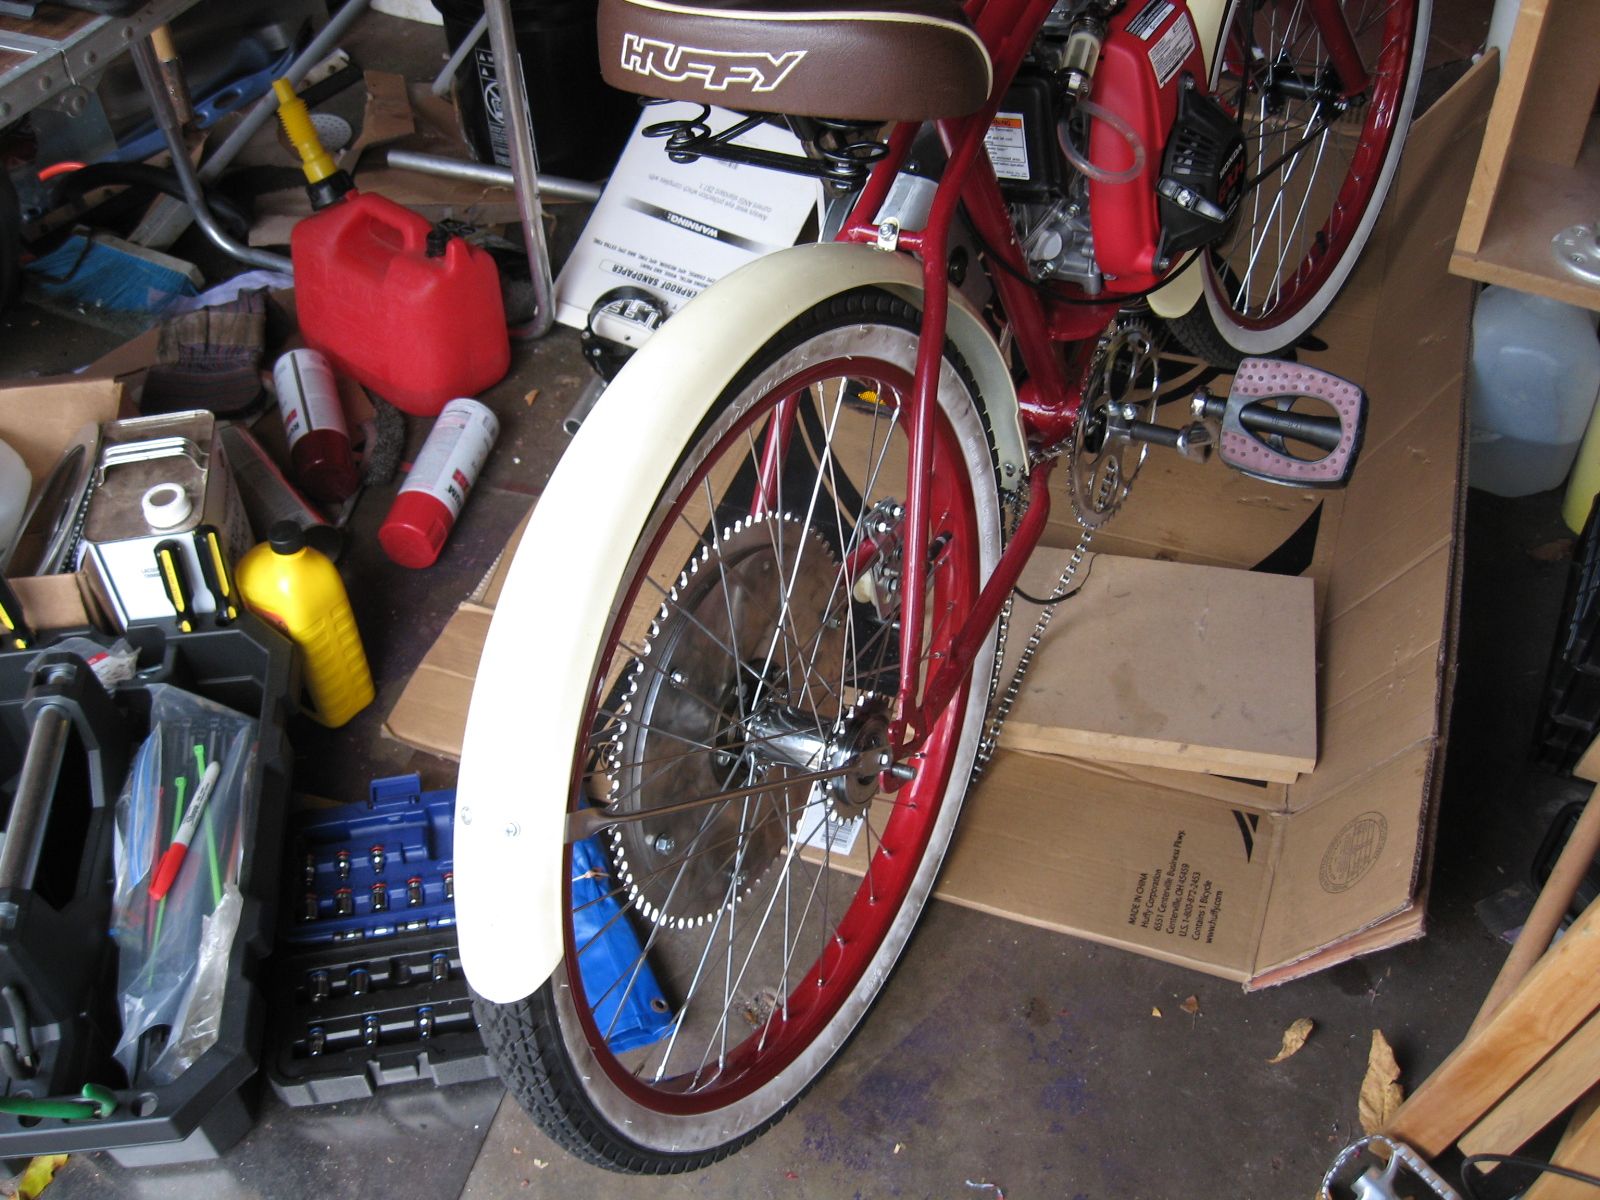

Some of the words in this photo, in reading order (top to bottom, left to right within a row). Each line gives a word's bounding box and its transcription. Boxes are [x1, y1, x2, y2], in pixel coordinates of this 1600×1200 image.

[620, 33, 809, 92] HUFFY
[612, 264, 659, 286] SANDPAPER
[660, 281, 698, 299] ERPROOF
[1167, 849, 1180, 877] Business
[1179, 863, 1190, 883] 45459
[1136, 873, 1148, 894] CHINA
[1146, 869, 1162, 909] Corporation
[1175, 885, 1185, 896] OH
[1134, 894, 1143, 903] IN
[1158, 878, 1173, 913] Centerville
[1128, 903, 1140, 925] MADE
[1141, 911, 1154, 928] Huffy
[1166, 898, 1182, 934] Centerville,
[1192, 910, 1206, 940] Contains
[1200, 880, 1213, 904] Bicycle
[1206, 891, 1223, 944] www.huffy.com
[1153, 914, 1164, 932] 6551
